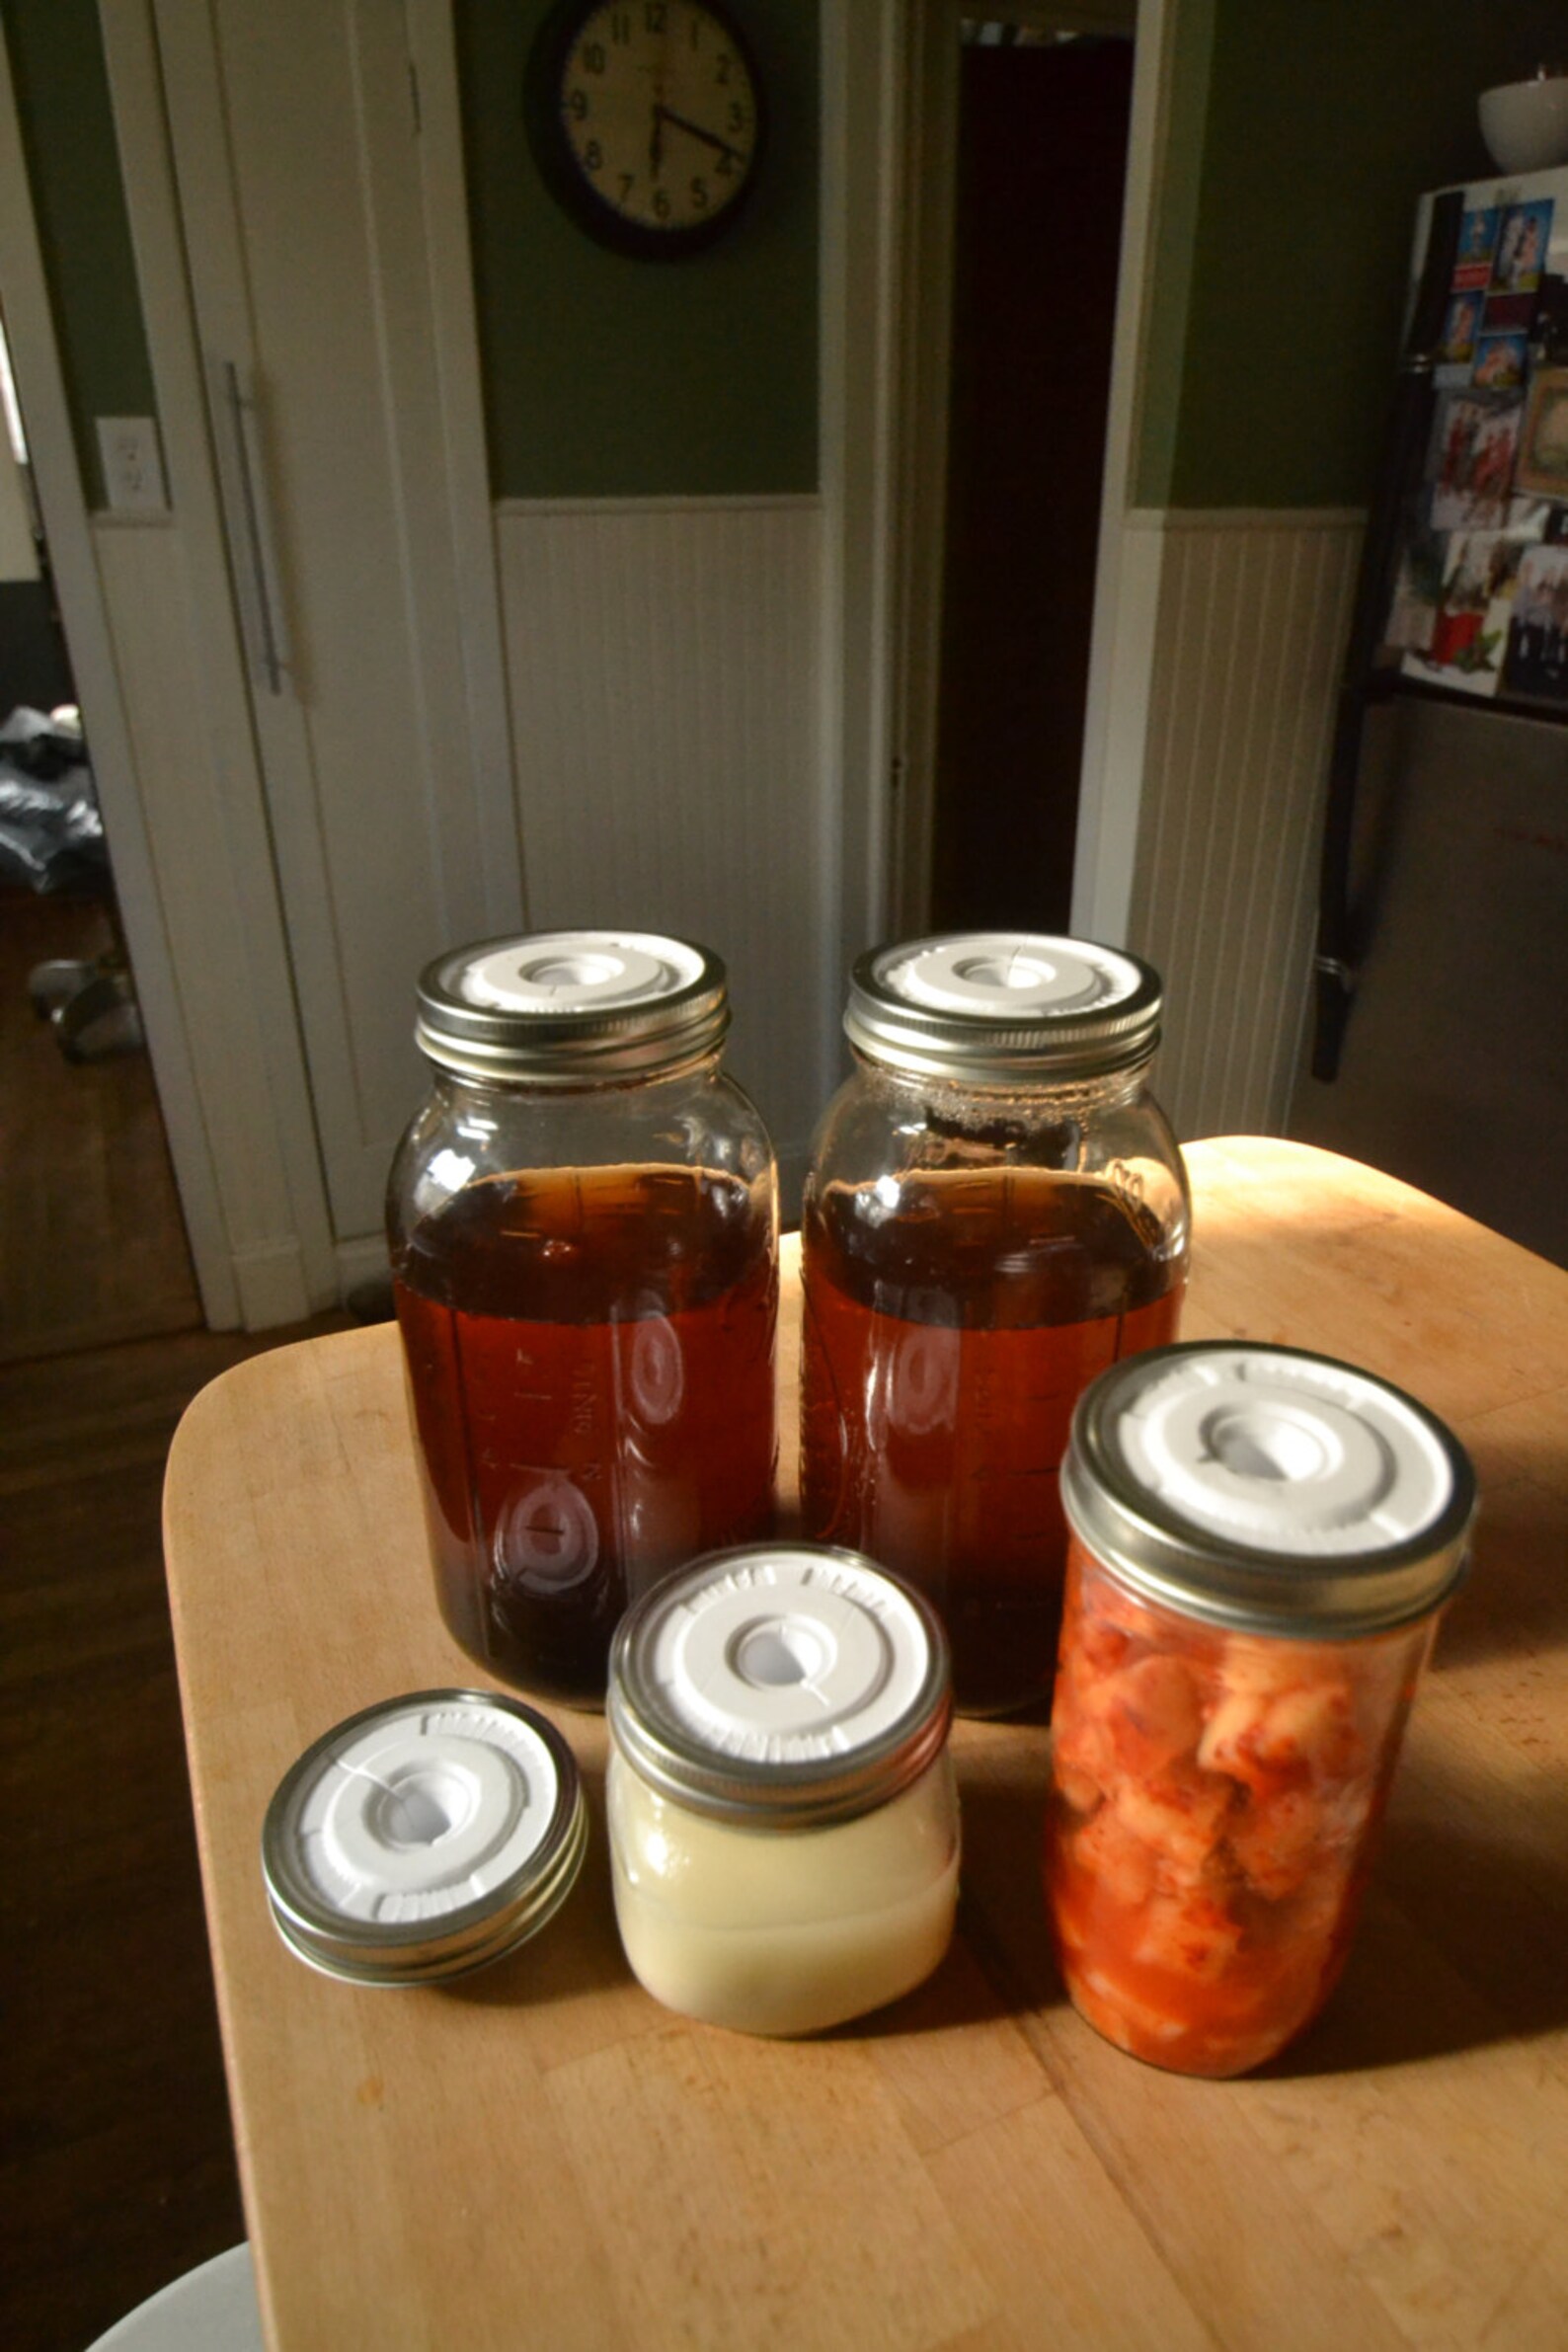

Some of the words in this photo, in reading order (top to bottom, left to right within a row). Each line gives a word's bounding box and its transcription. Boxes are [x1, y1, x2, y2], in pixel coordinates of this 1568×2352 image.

[611, 13, 631, 45] 11
[645, 1, 666, 34] 12
[690, 20, 699, 51] 1
[583, 41, 606, 75] 10
[715, 52, 730, 85] 2
[571, 89, 588, 120] 9
[727, 102, 745, 132] 3
[585, 139, 602, 170] 8
[617, 173, 635, 203] 7
[652, 188, 671, 219] 6
[689, 176, 708, 208] 5
